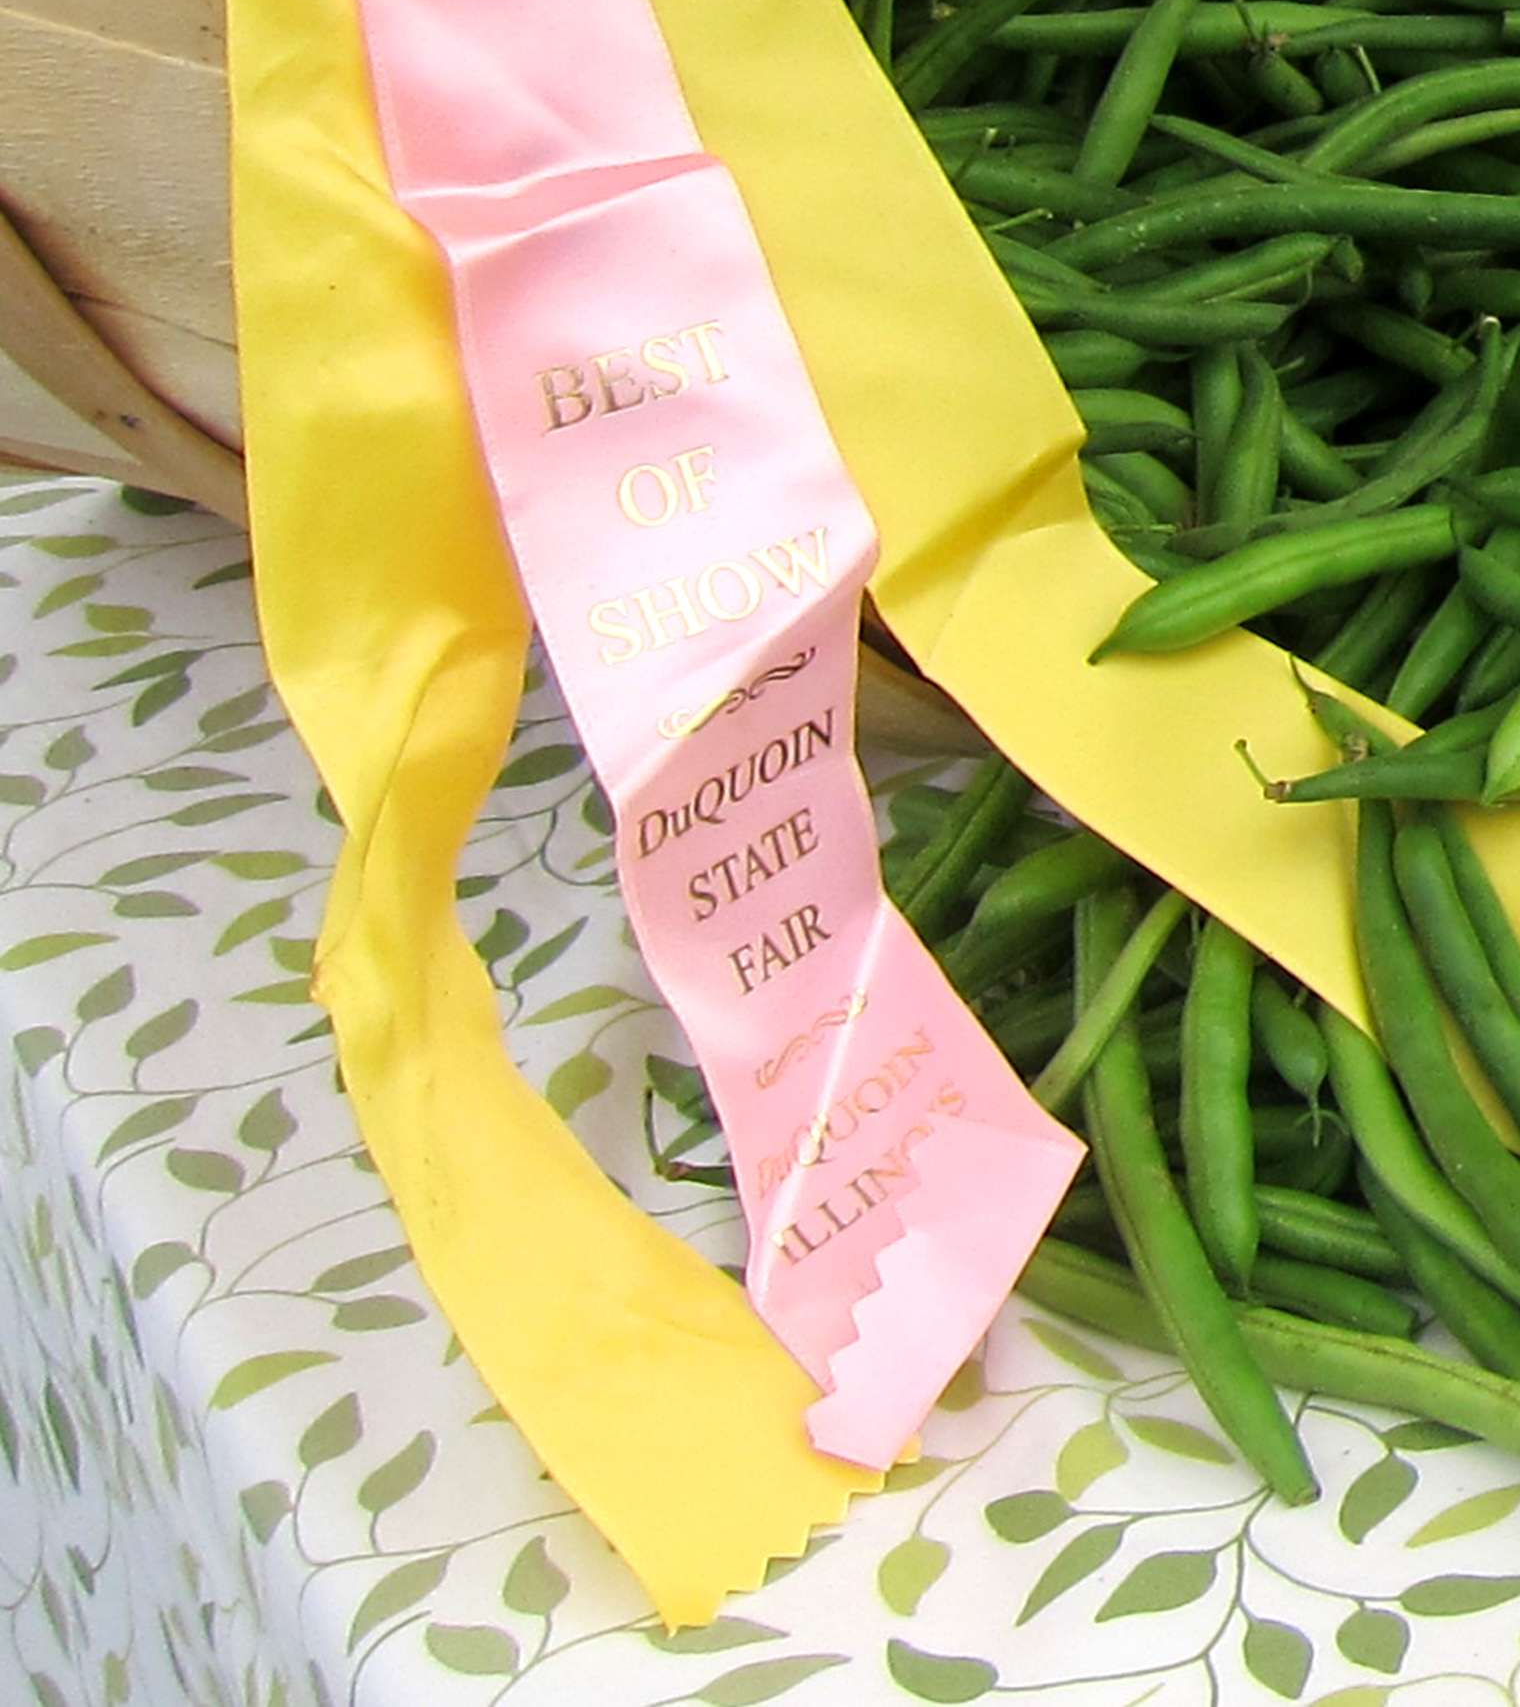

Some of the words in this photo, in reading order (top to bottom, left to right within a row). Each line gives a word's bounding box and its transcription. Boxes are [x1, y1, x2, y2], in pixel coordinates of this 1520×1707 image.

[535, 321, 730, 434] BEST
[617, 445, 719, 528] OF
[588, 526, 834, 667] SHOW
[636, 707, 836, 860] DuQUOIN
[686, 808, 821, 925] STATE
[726, 904, 832, 997] FAIR
